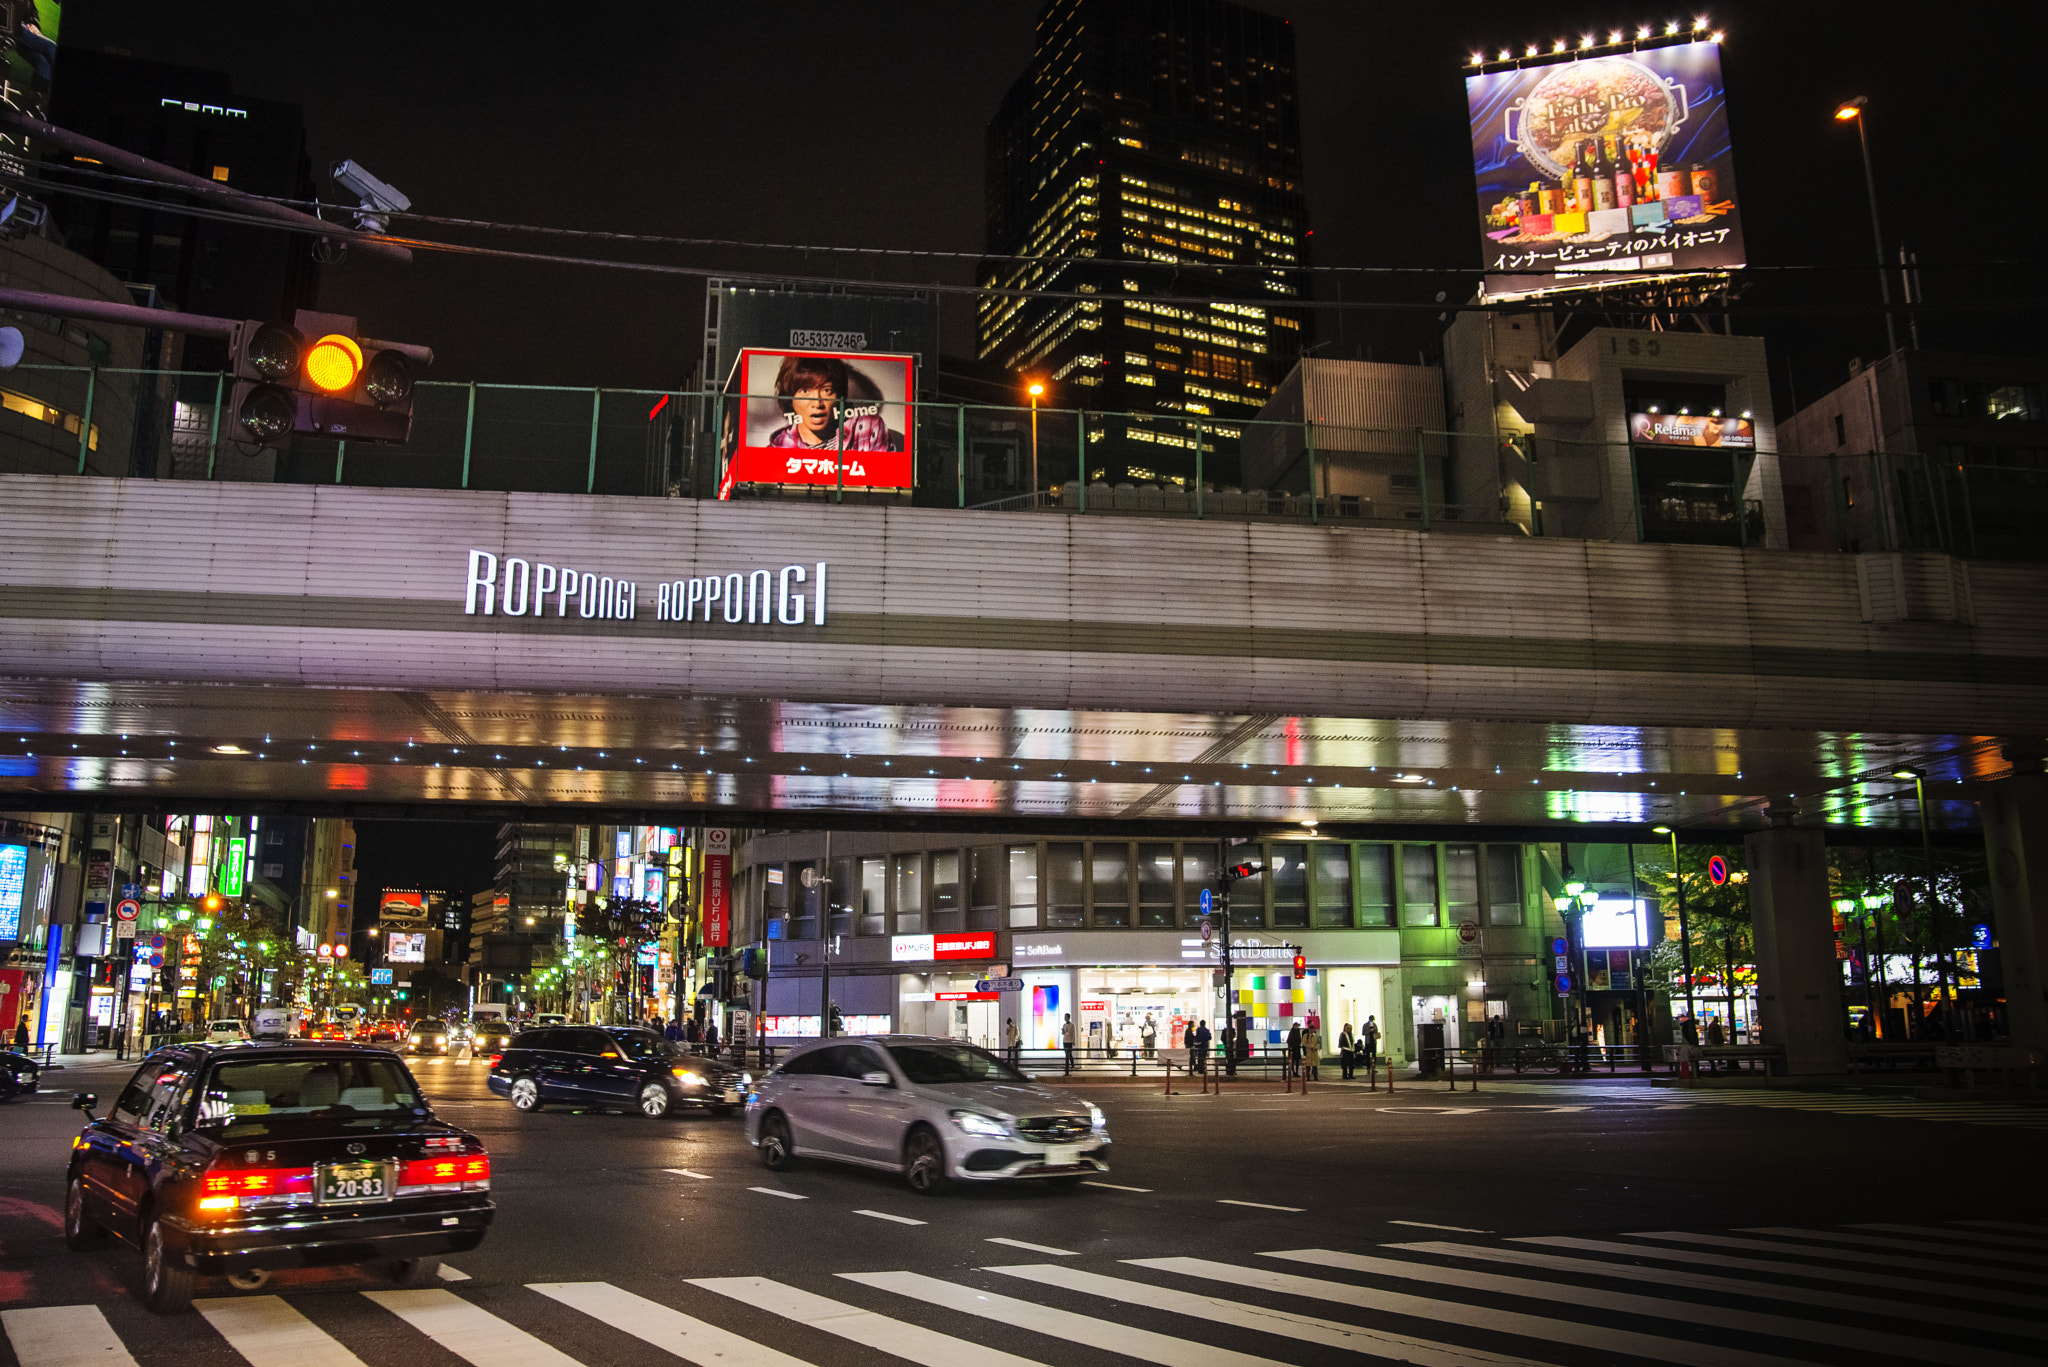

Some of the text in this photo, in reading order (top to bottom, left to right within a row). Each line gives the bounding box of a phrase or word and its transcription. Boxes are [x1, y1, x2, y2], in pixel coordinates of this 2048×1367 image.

[161, 98, 247, 119] remm
[1609, 92, 1647, 111] Pro
[1654, 422, 1704, 437] Relamax
[786, 457, 866, 476] タマホーム
[465, 549, 826, 626] ROPPONGI ROPPONGI
[710, 859, 722, 942] 三菱東京UFJ銀行
[907, 943, 931, 951] MUFG
[1026, 944, 1063, 956] SoftBank
[336, 1178, 383, 1198] 20-83
